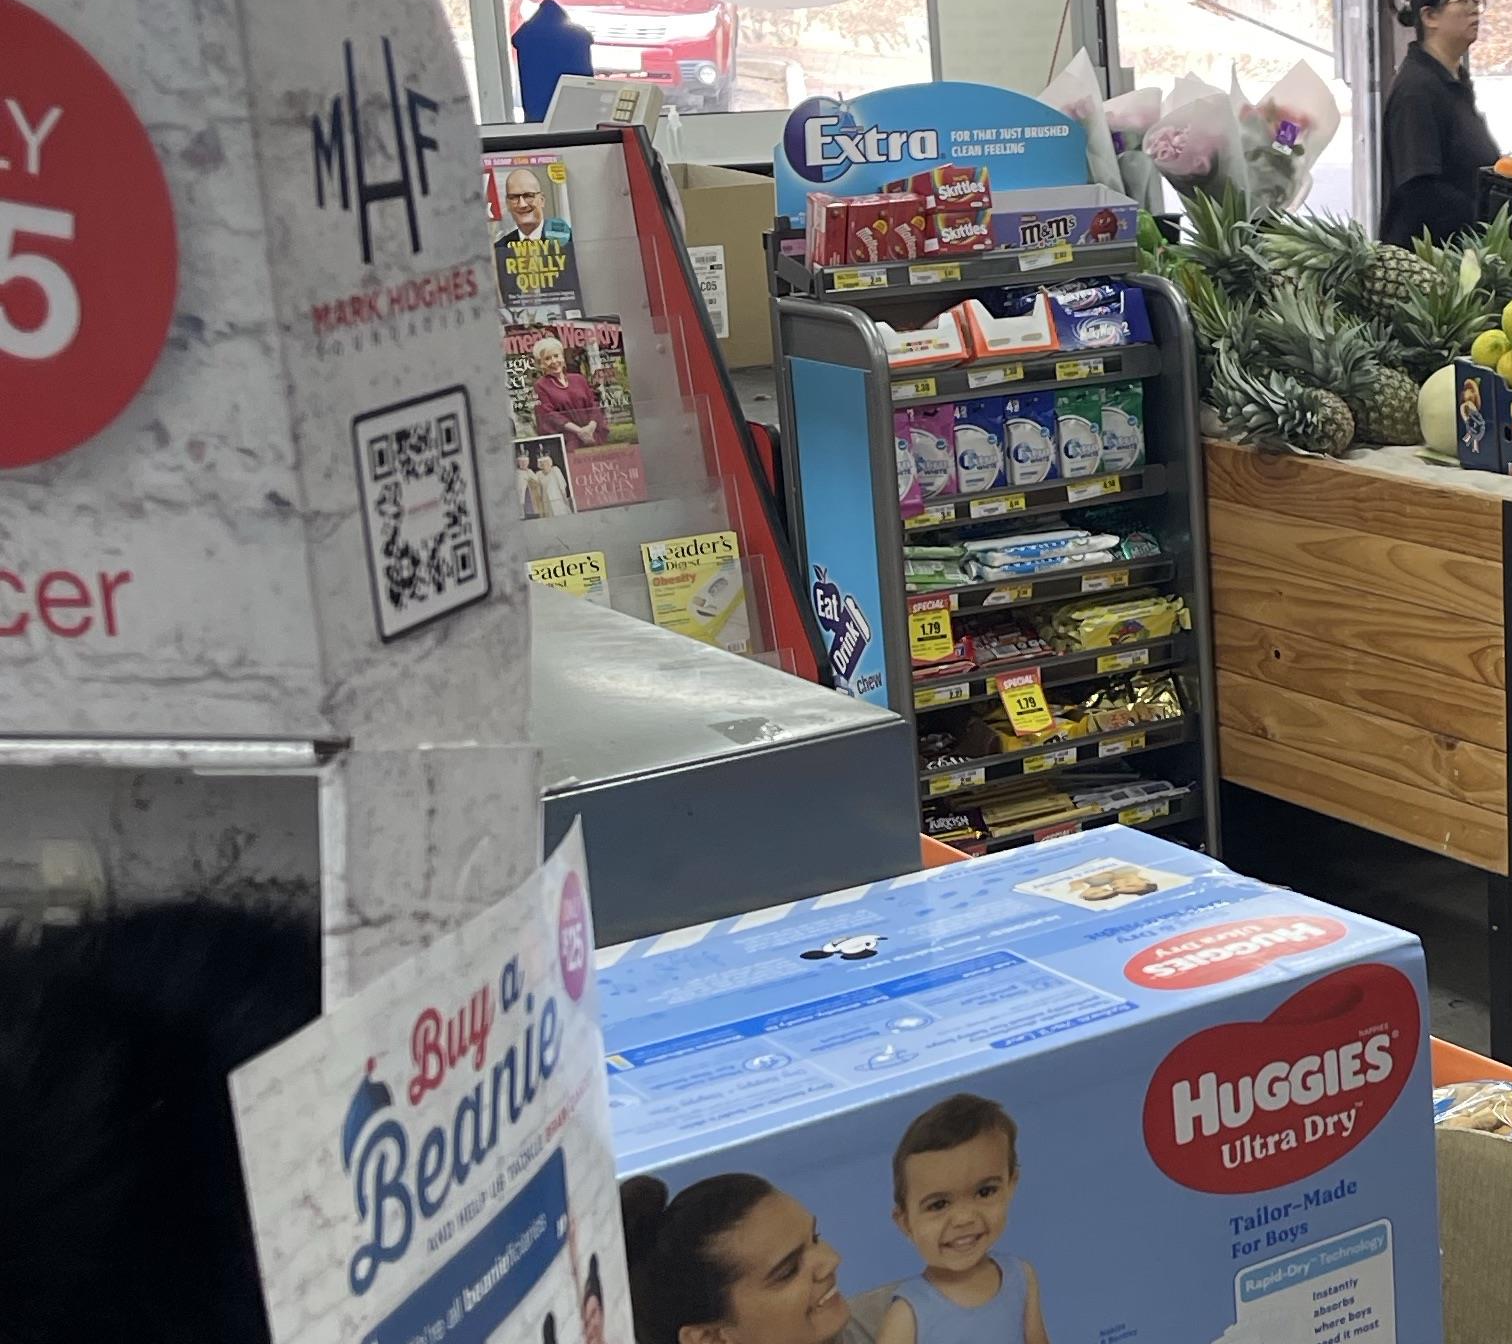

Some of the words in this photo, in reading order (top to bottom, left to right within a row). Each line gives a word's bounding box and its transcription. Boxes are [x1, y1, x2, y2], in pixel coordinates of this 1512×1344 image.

[804, 117, 940, 167] Extra
[951, 130, 971, 142] FOR
[972, 128, 998, 141] THAT
[999, 127, 1022, 140] JUST
[1025, 125, 1069, 138] BRUSHED
[310, 36, 440, 264] MHF
[951, 144, 981, 157] CLEAN
[982, 142, 1025, 155] FEELING
[938, 180, 986, 200] Skittles
[941, 222, 989, 242] Skittles
[555, 240, 561, 255] I
[506, 255, 566, 274] REALLY
[516, 274, 559, 293] QUIT'
[312, 290, 383, 336] MARK
[557, 322, 621, 349] Weekly
[665, 557, 702, 572] Digest
[652, 573, 696, 587] Obesity
[816, 588, 840, 621] Eat
[912, 599, 945, 613] SPECIAL
[833, 622, 862, 674] Drink
[1002, 675, 1037, 690] SPECIAL
[925, 814, 970, 830] TURKISH
[408, 984, 496, 1106] Buy
[500, 953, 526, 1013] a
[1172, 1034, 1393, 1145] HUGGIES
[349, 992, 564, 1296] Beanie
[1221, 1128, 1298, 1169] Ultra
[1303, 1107, 1357, 1144] Dry
[1229, 1179, 1358, 1235] Tailor-Made
[1231, 1241, 1261, 1259] For
[1266, 1221, 1309, 1247] Boys
[1245, 1261, 1311, 1293] Rapid-Dry
[1320, 1235, 1385, 1266] Technology
[1312, 1278, 1359, 1301] Instantly
[1313, 1295, 1355, 1318] absorbs
[1314, 1317, 1346, 1334] where
[1348, 1306, 1372, 1325] boys
[1343, 1330, 1351, 1342] it
[1353, 1318, 1380, 1338] most
